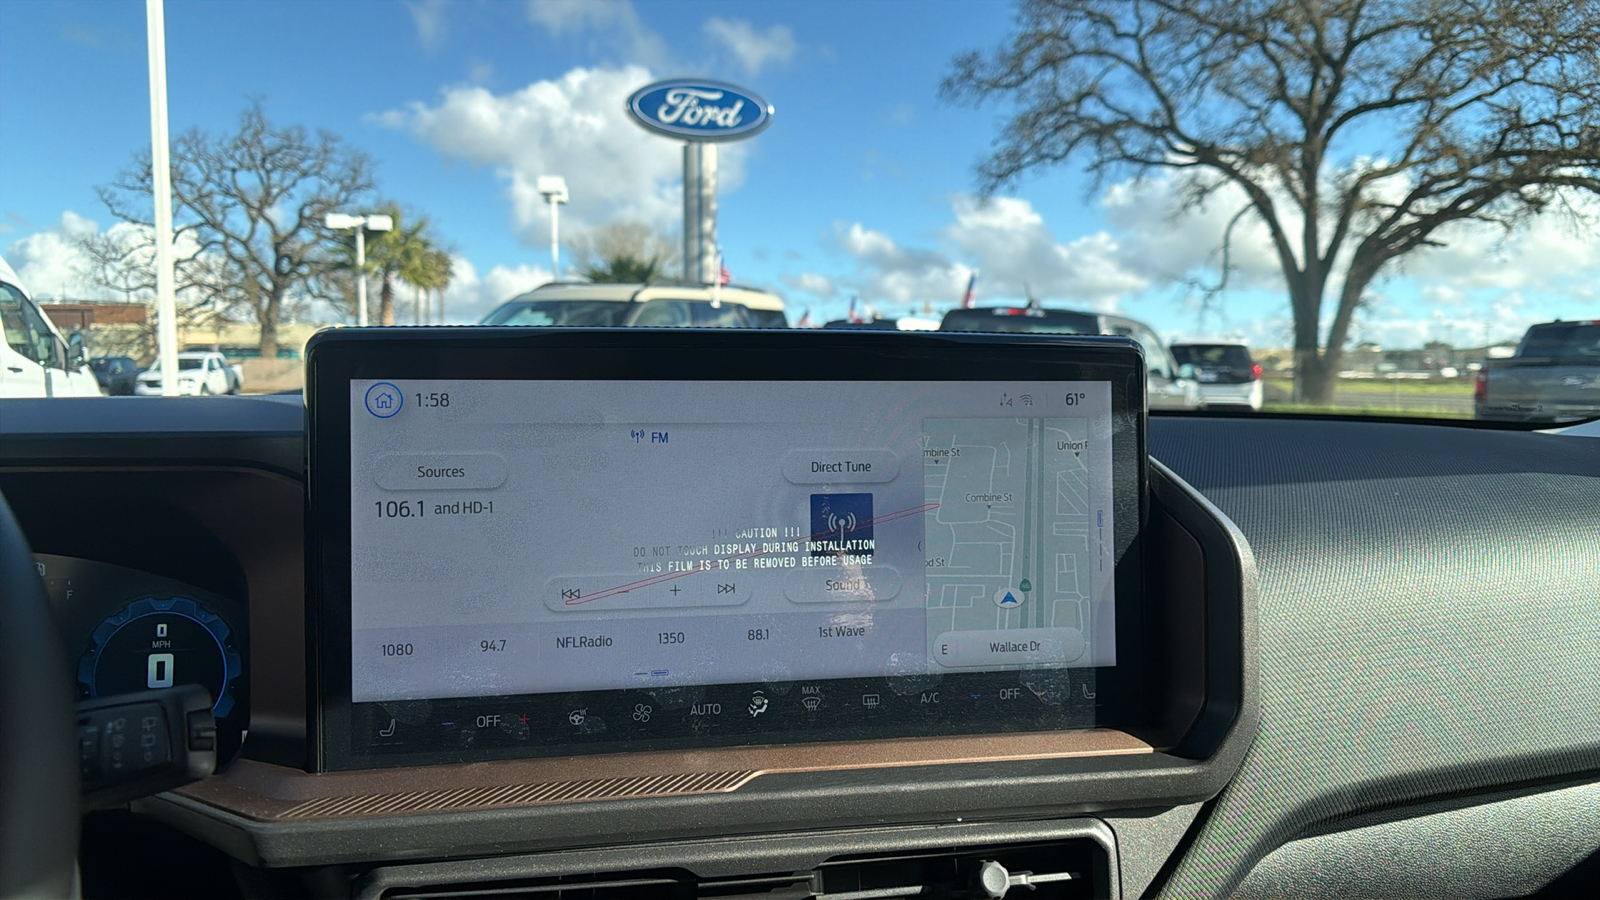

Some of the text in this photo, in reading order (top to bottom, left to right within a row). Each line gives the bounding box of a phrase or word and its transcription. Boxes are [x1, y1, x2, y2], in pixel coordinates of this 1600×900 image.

[657, 88, 744, 127] Ford
[414, 392, 450, 408] 1:58
[1065, 392, 1086, 406] 61°
[651, 432, 669, 444] FM
[951, 447, 960, 457] St
[1057, 440, 1083, 451] Union
[417, 465, 465, 479] Sources
[811, 460, 871, 473] Direct Tune
[965, 493, 1013, 503] Combine St
[374, 500, 494, 518] 106.1 and HD-1
[735, 527, 778, 539] CAUTION
[784, 526, 801, 538] !!!
[633, 539, 875, 558] DO NOT TOUCH DISPLAY DURING INSTALLATION
[637, 554, 873, 573] THIS FILM IS TO BE REMOVED BEFORE USAGE
[935, 557, 945, 567] St
[825, 578, 860, 591] Sound
[66, 590, 74, 600] F
[157, 624, 167, 637] 0
[747, 628, 770, 641] 88.1
[818, 625, 866, 638] 1st Wave
[556, 635, 613, 649] NFLRadio
[658, 631, 685, 644] 1350
[152, 640, 171, 649] MPH
[381, 643, 414, 657] 1080
[480, 639, 507, 652] 94.7
[941, 640, 1041, 655] E Wallace Dr
[802, 685, 821, 695] MAX
[1000, 688, 1021, 700] OFF
[920, 691, 940, 704] A/C
[690, 703, 722, 716] AUTO
[476, 715, 501, 728] OFF
